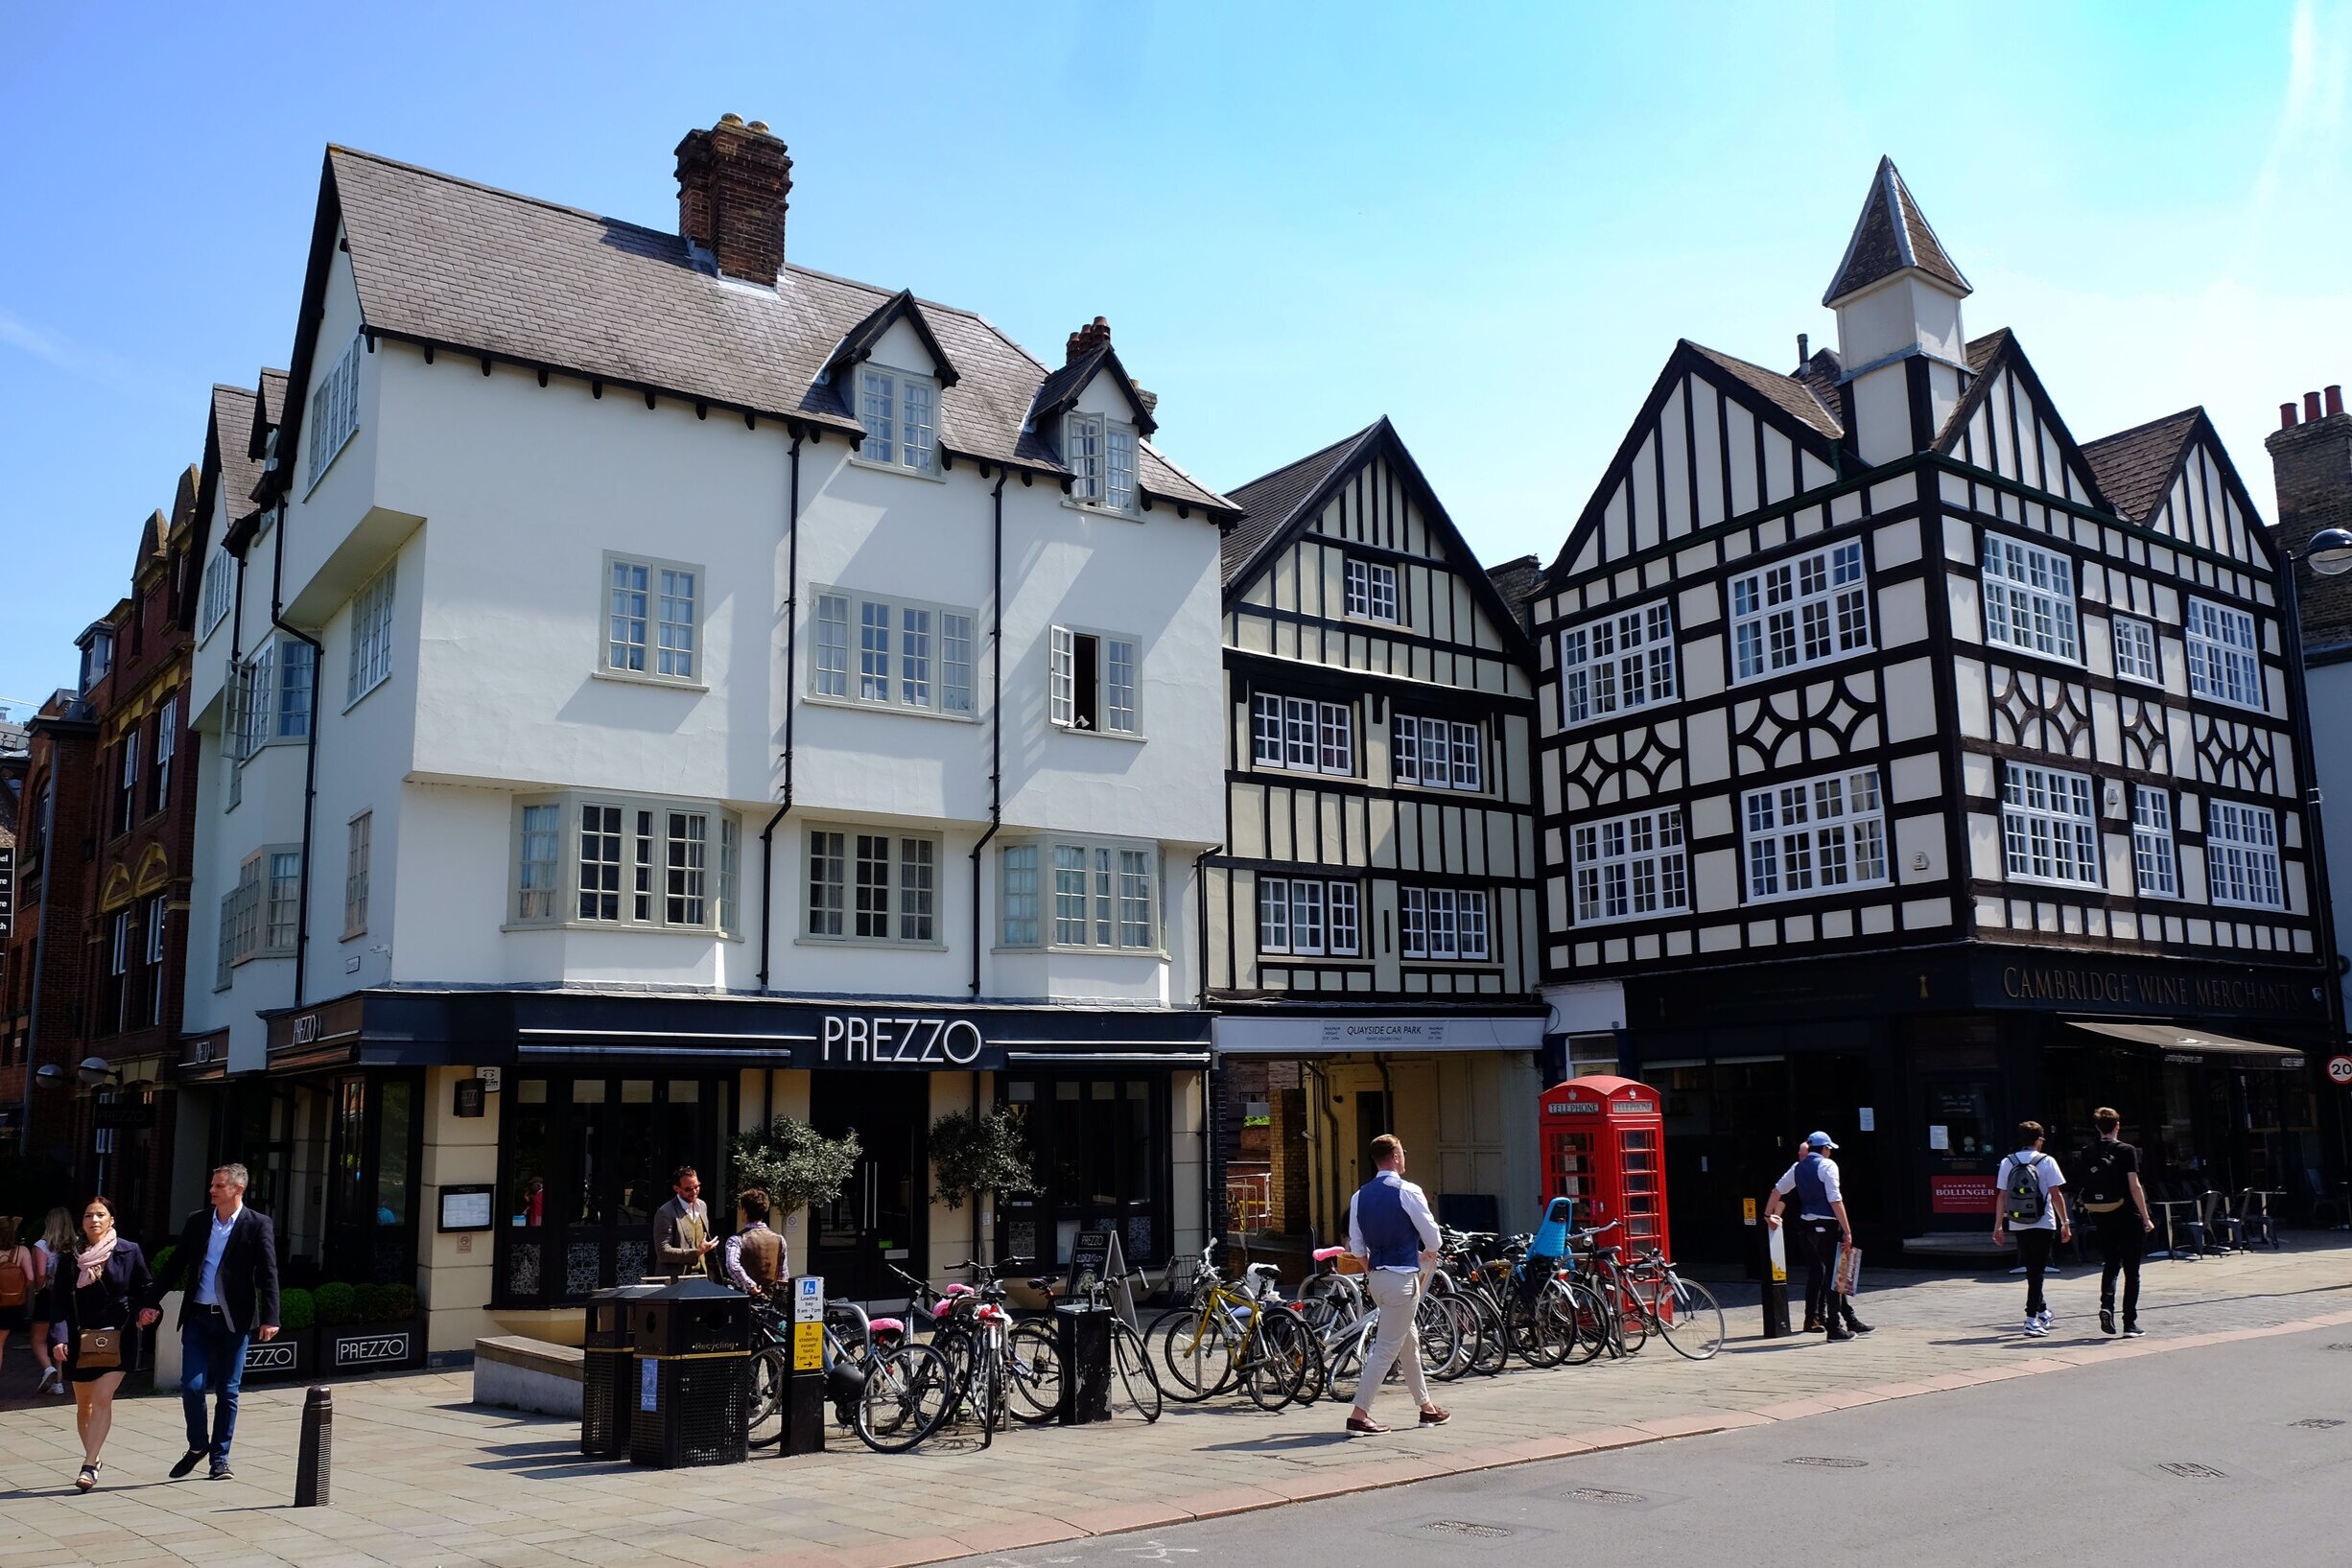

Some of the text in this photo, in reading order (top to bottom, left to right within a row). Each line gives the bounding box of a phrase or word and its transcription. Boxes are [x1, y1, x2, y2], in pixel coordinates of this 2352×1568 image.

[2004, 967, 2301, 1011] CAMBRIDGE WINE MERCHANTS
[1347, 1025, 1422, 1036] QUAYSIDE CAR PARK
[823, 1016, 982, 1065] PREZZO
[2331, 1064, 2352, 1075] 20
[1550, 1104, 1597, 1113] TELEPHONE
[1614, 1102, 1651, 1112] TELEPHONE
[99, 1110, 147, 1123] PREZZO
[1080, 1235, 1104, 1246] PREZZO
[341, 1340, 405, 1360] PREZZO
[695, 1342, 735, 1352] Recycling
[244, 1347, 293, 1368] EZZO
